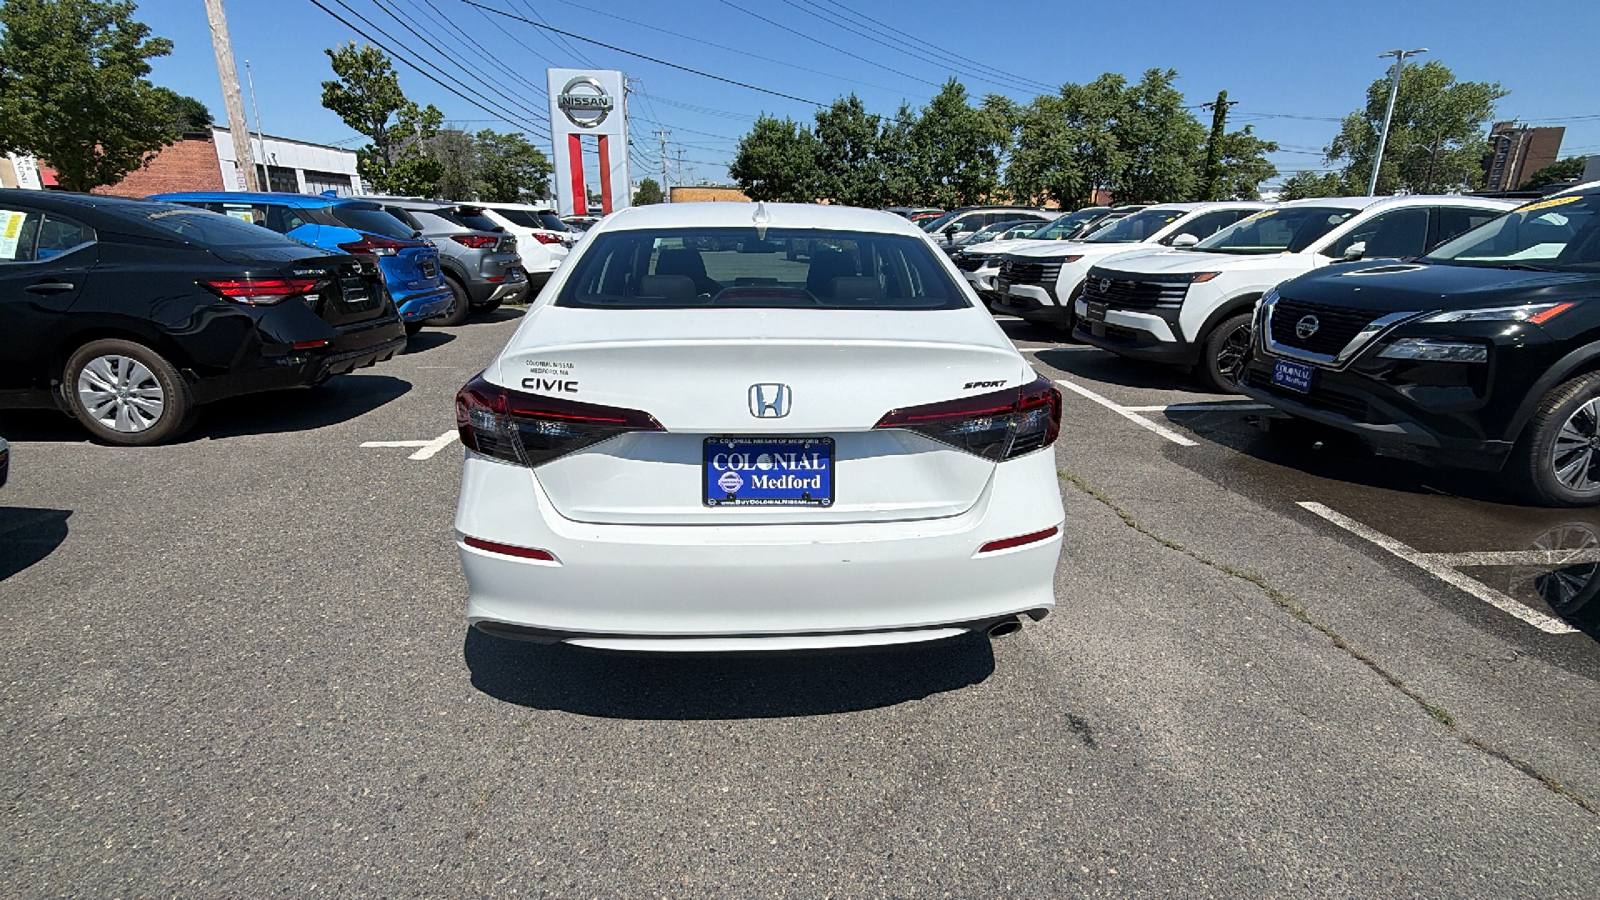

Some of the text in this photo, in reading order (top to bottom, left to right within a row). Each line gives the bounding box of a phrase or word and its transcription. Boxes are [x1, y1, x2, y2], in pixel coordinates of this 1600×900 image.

[563, 97, 608, 106] NISSAN
[1275, 363, 1311, 379] COLONIAL
[521, 378, 579, 393] CIVIC
[962, 380, 1007, 390] SPORT
[712, 452, 826, 471] COLONIAL
[751, 474, 821, 489] Medford
